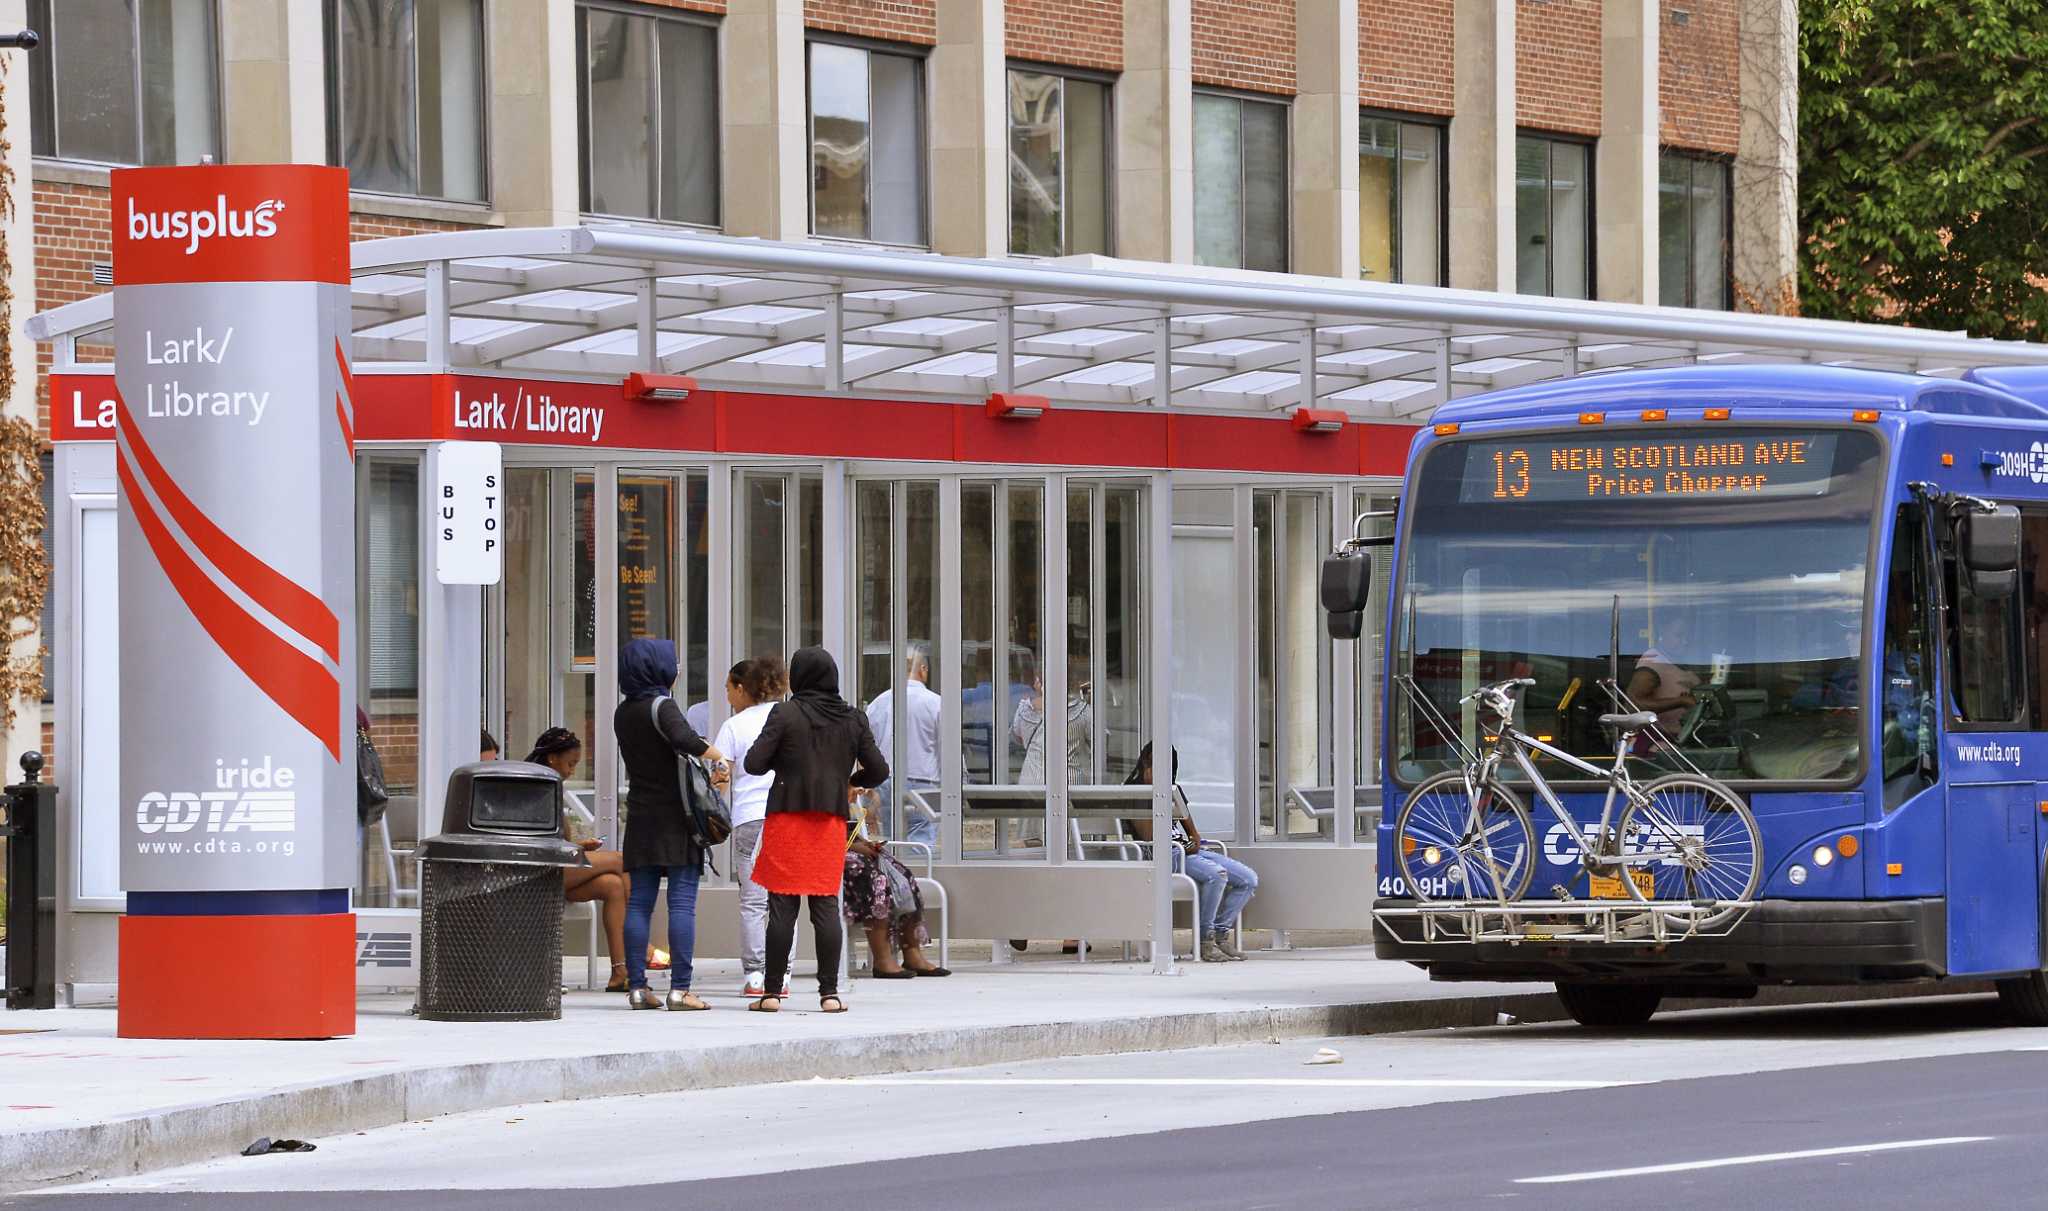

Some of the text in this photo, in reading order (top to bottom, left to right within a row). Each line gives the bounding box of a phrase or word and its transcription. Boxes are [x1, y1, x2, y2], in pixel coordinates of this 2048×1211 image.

[146, 327, 233, 365] Lark/
[147, 381, 269, 426] Library
[1493, 442, 1805, 498] 13 NEW SCOTLAND AVE
[1588, 471, 1767, 496] Price Chopper
[443, 485, 454, 542] BUS
[484, 475, 496, 552] STOP
[216, 755, 296, 789] iride
[1957, 741, 2020, 767] www.cdta.org
[136, 791, 296, 834] CDTA
[137, 838, 296, 857] www.cdta.org
